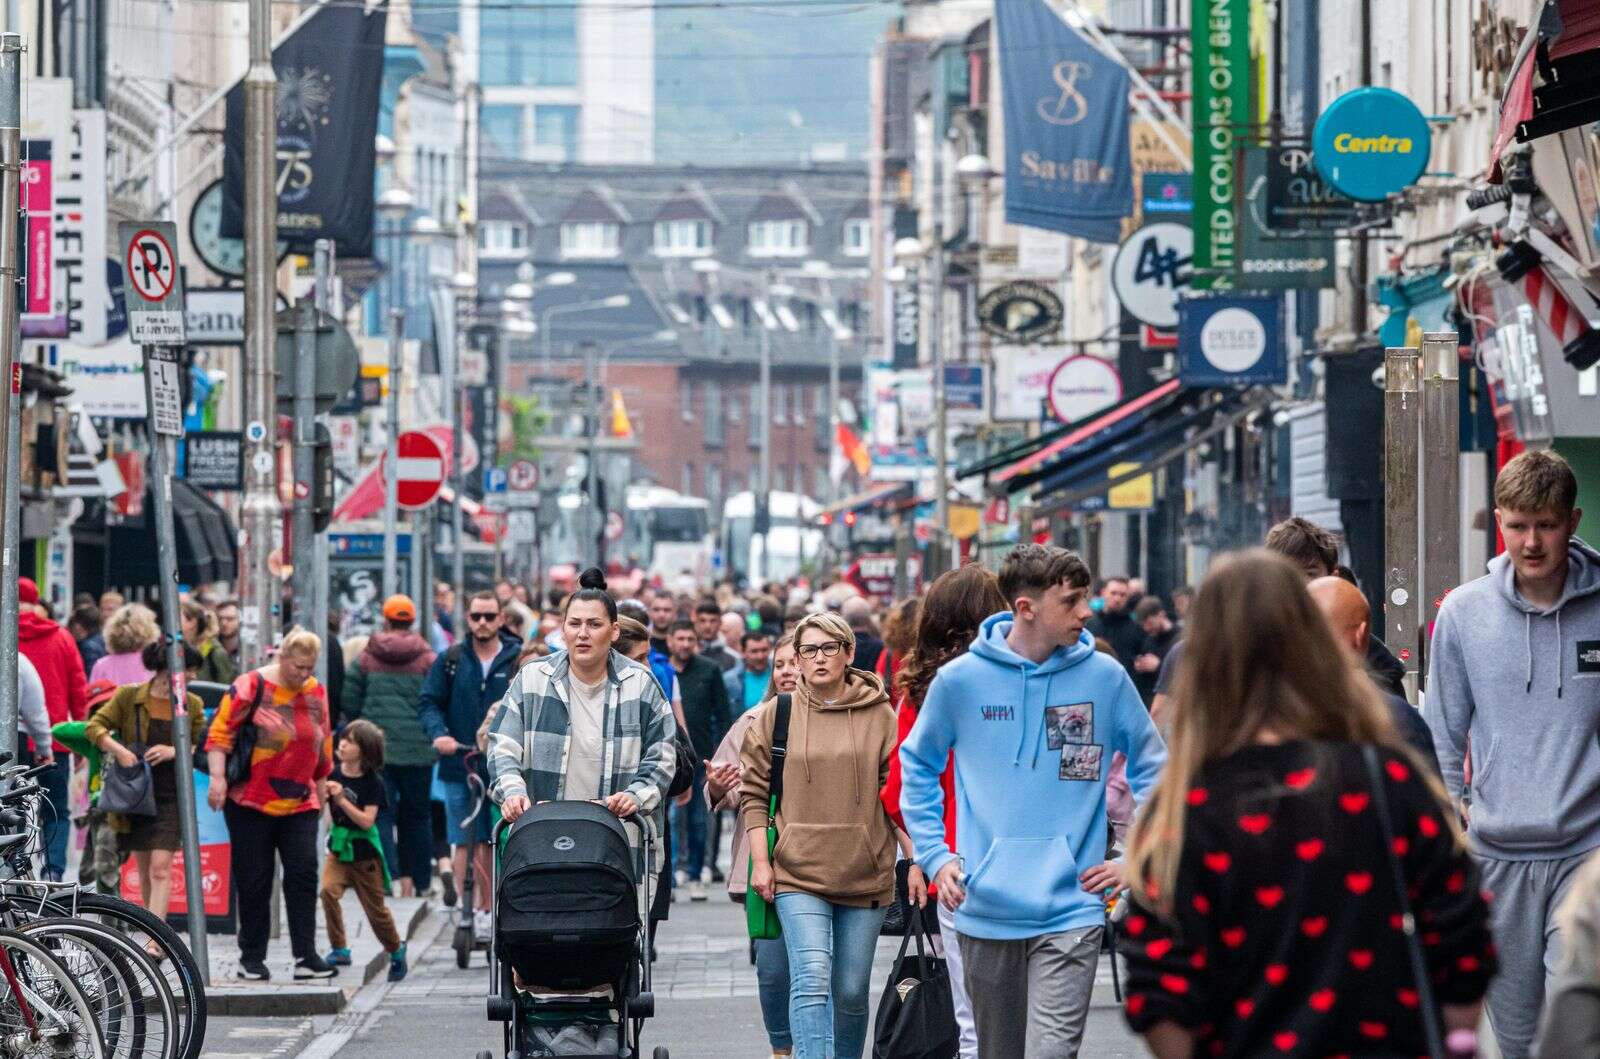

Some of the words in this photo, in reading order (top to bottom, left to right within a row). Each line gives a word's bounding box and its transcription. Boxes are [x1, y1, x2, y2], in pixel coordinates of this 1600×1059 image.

[1209, 54, 1232, 91] OF
[1209, 95, 1233, 204] COLORS
[1334, 133, 1412, 153] Centra
[1210, 208, 1234, 289] NITED
[1243, 259, 1327, 273] BOOKSHOP
